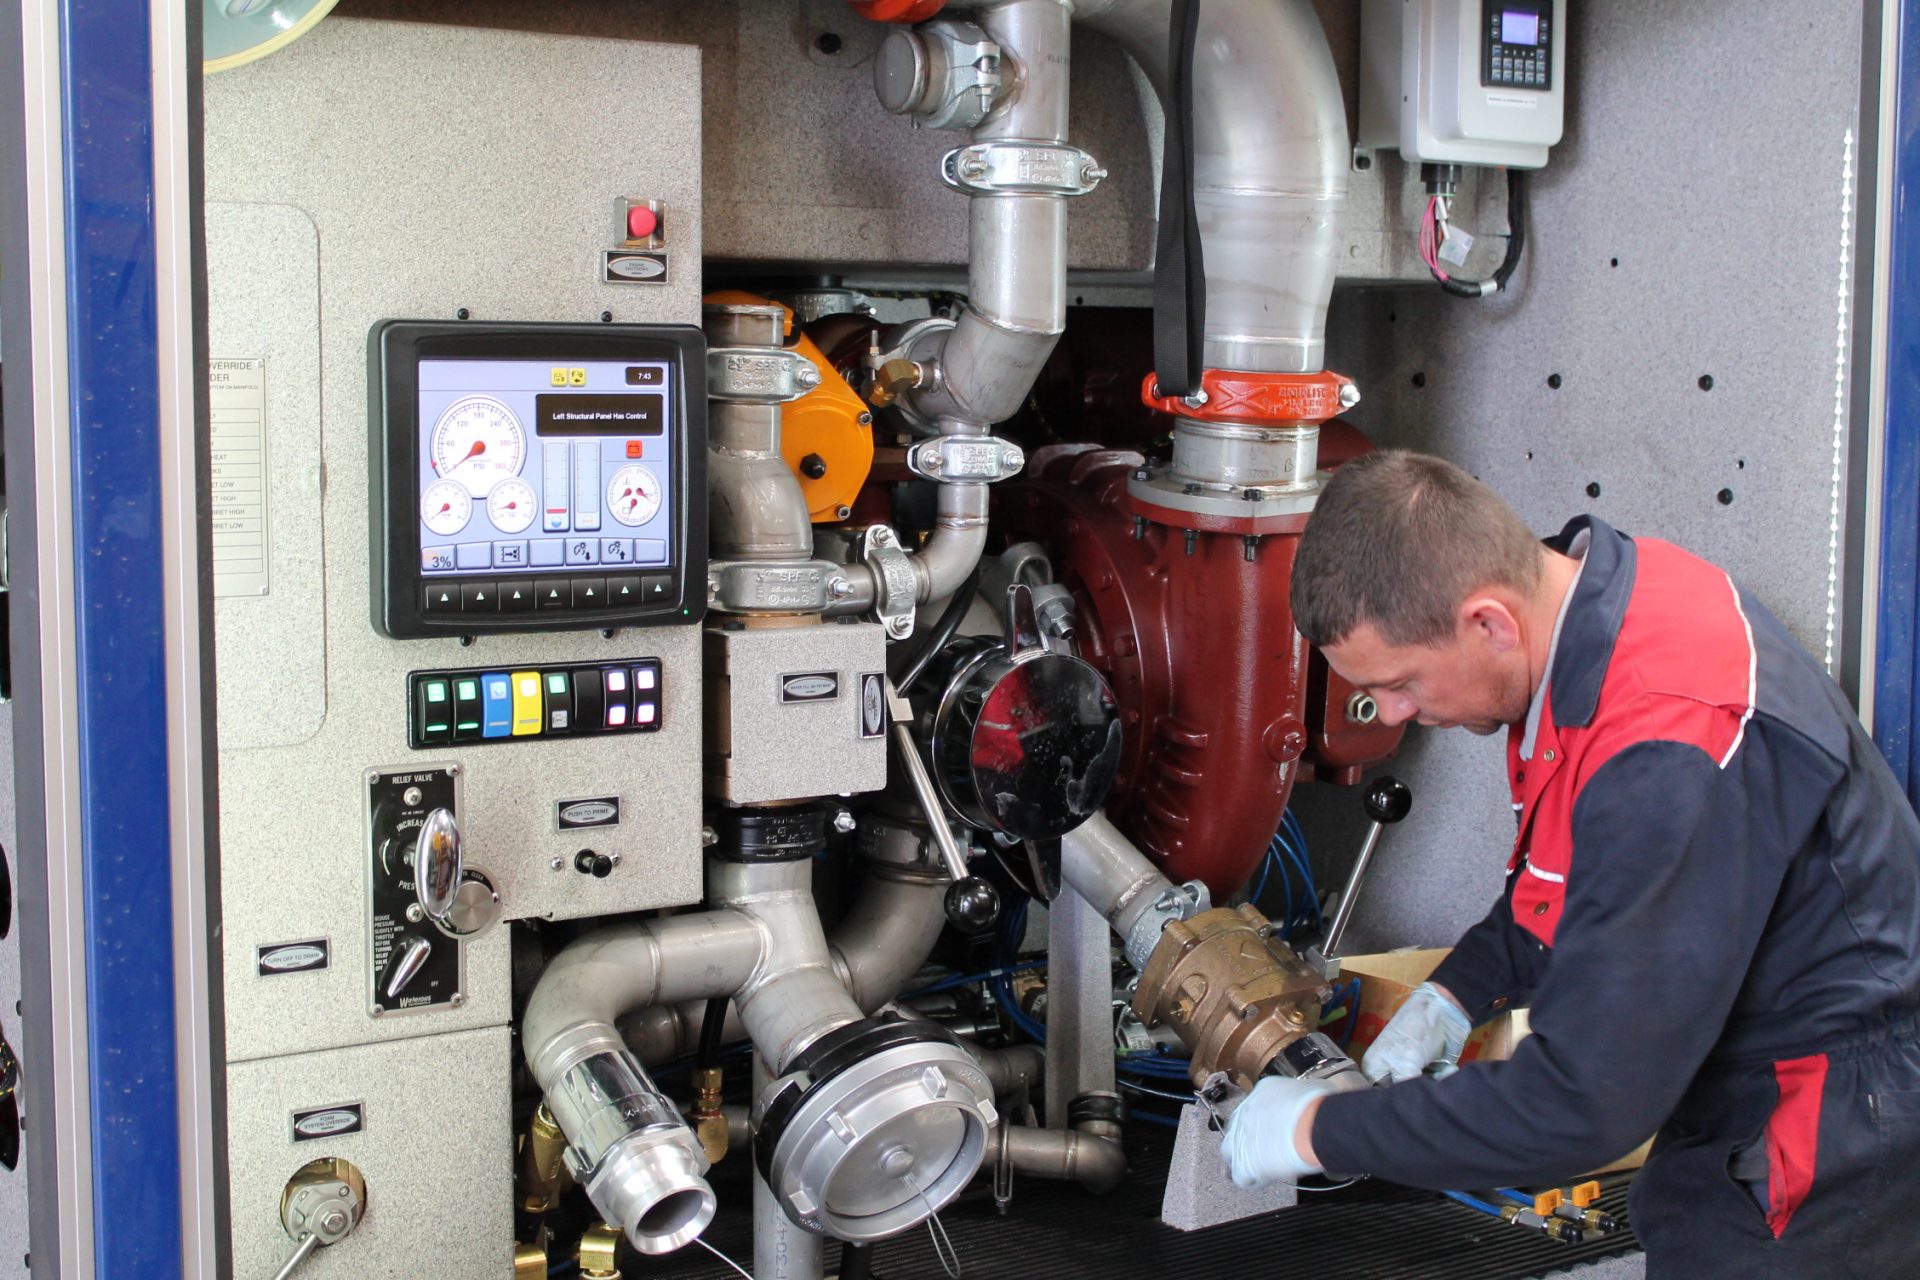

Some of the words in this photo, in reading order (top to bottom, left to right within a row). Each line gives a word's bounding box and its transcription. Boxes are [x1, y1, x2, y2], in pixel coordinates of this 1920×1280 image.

[209, 361, 252, 370] VERRIDE
[637, 372, 652, 381] 7:43
[552, 412, 565, 420] Left
[566, 412, 595, 420] Structural
[595, 412, 612, 420] Panel
[613, 412, 625, 420] Has
[625, 412, 647, 420] Control
[432, 556, 452, 568] 3%
[392, 775, 412, 785] RELIEF
[414, 773, 433, 783] VALVE
[396, 818, 424, 832] INCREAS
[398, 880, 416, 890] PRES
[304, 1121, 325, 1129] SYSTEM
[775, 1203, 788, 1280] P304/
